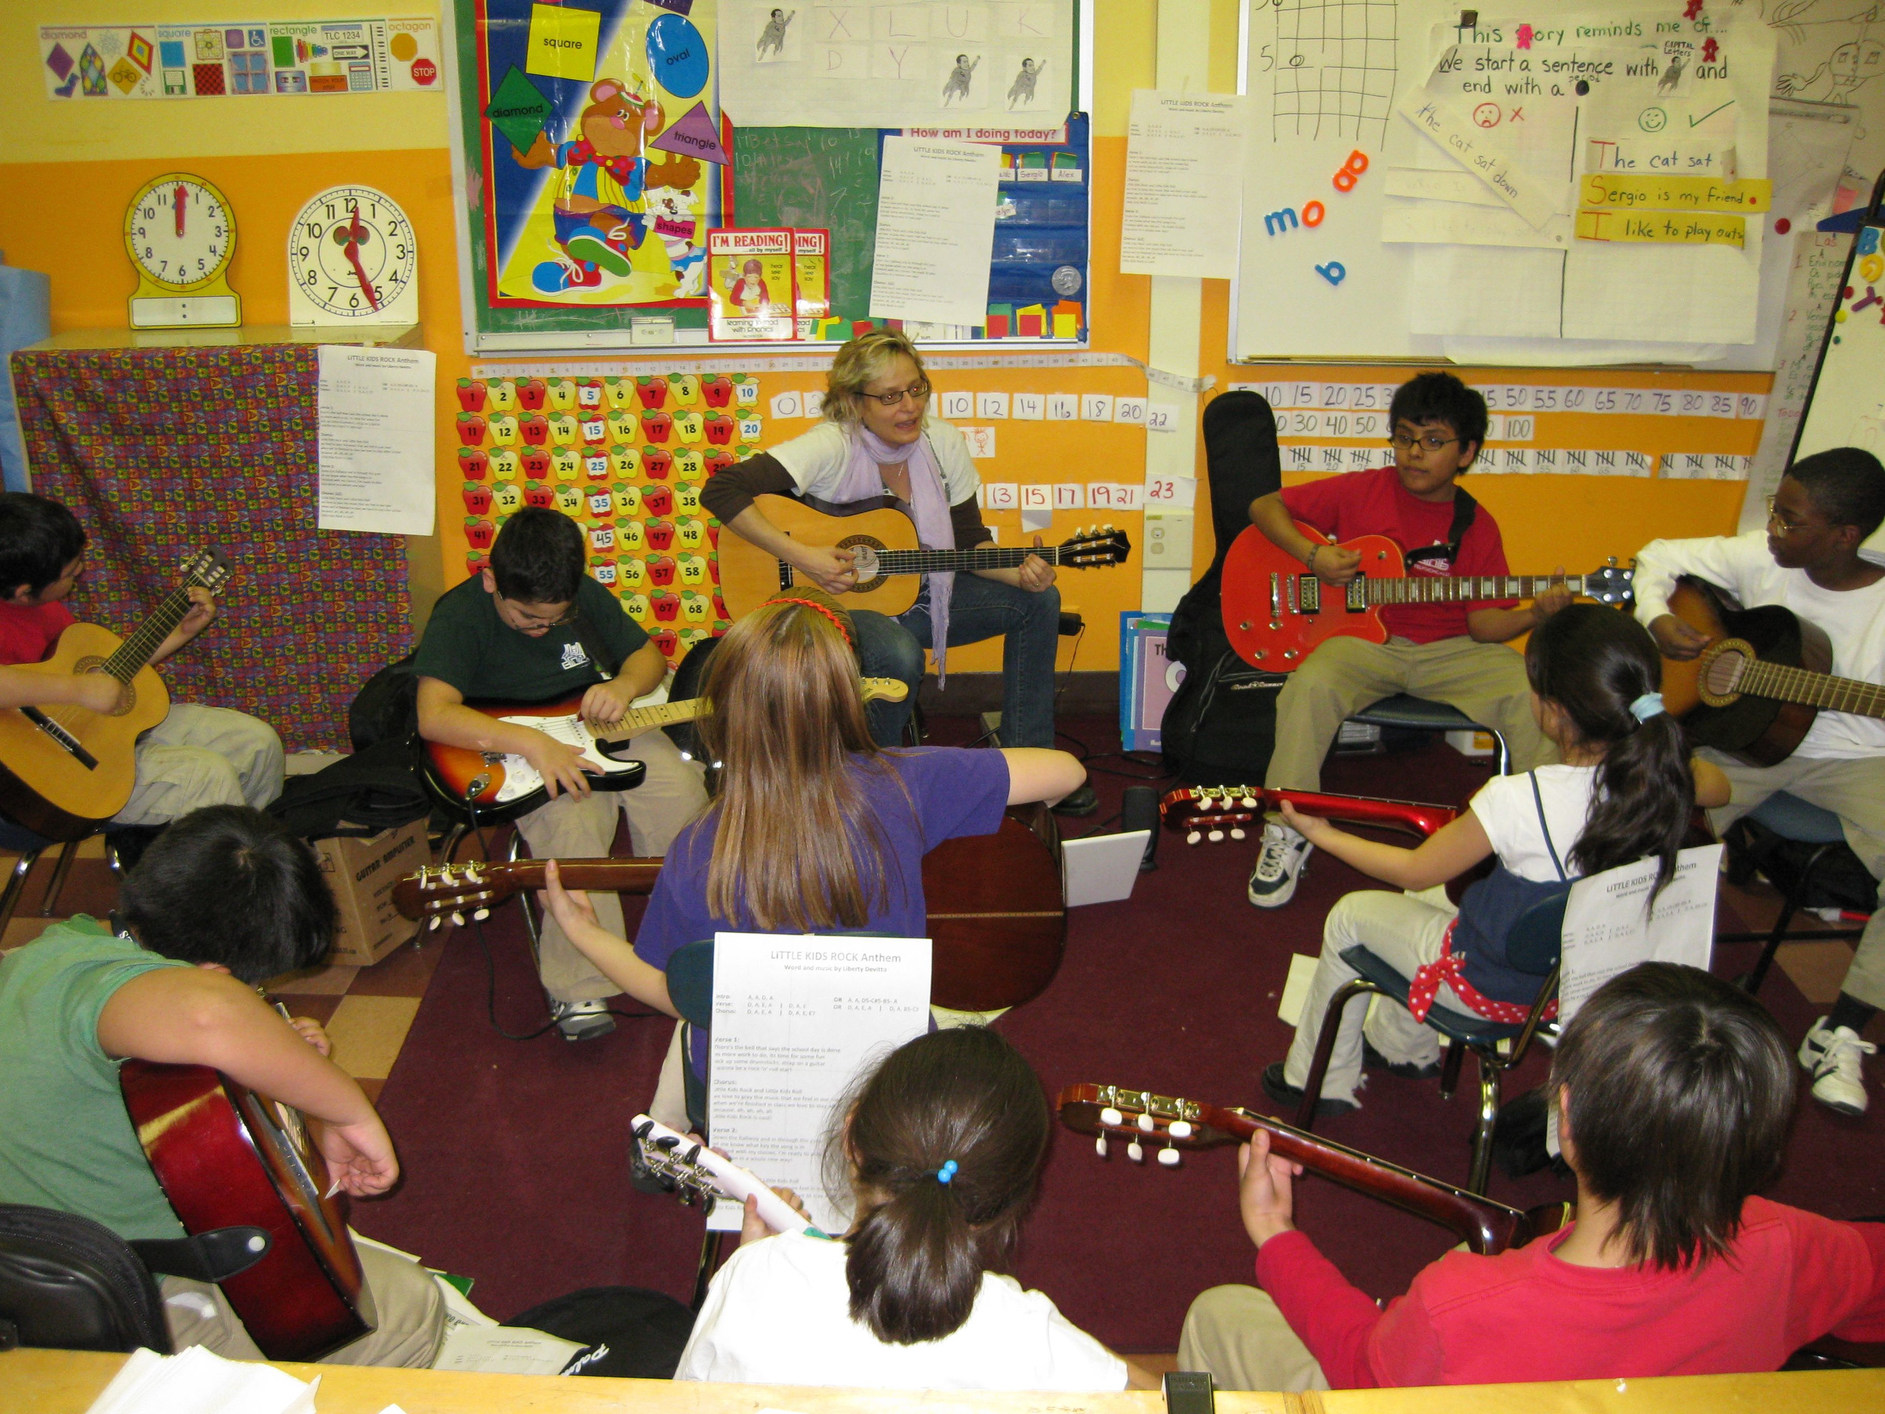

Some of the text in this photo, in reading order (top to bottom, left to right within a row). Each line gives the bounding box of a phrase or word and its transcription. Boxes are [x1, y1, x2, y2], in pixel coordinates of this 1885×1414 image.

[157, 29, 191, 39] square
[269, 24, 317, 36] rectangle
[388, 22, 432, 32] octagon
[1453, 23, 1503, 44] This
[1576, 20, 1642, 38] reminds
[1656, 21, 1680, 33] me
[40, 30, 87, 40] diamond
[324, 31, 361, 40] TLC 1234
[543, 37, 583, 51] square
[665, 48, 691, 66] oval
[1439, 47, 1727, 79] We start a sentence with and
[413, 67, 435, 77] STOP
[1462, 75, 1565, 96] end with a
[492, 104, 544, 118] diamond
[673, 130, 717, 151] triangle
[911, 128, 1057, 141] How am I doing today?
[1590, 140, 1713, 169] The cat sat
[1449, 133, 1474, 154] cat
[1473, 153, 1497, 178] sat
[1493, 168, 1520, 200] down
[1587, 175, 1647, 205] Sergio
[1657, 188, 1670, 201] is
[1679, 193, 1699, 204] my
[158, 194, 167, 205] 11
[344, 198, 358, 213] 12
[144, 207, 155, 219] 10
[208, 206, 215, 217] 2
[325, 204, 335, 219] 11
[138, 227, 146, 238] 9
[215, 226, 222, 237] 3
[306, 223, 322, 239] 10
[388, 221, 398, 236] 2
[656, 221, 693, 236] shapes
[1625, 219, 1655, 238] like
[1664, 219, 1678, 236] to
[1685, 222, 1712, 241] play
[712, 233, 788, 252] I'M READING!
[299, 246, 309, 262] 9
[396, 244, 406, 260] 3
[179, 265, 186, 276] 6
[349, 293, 360, 308] 6
[374, 286, 383, 301] 5
[500, 387, 753, 401] 2 3 4 5 6 8 10
[1292, 386, 1376, 407] 15 20 25
[1506, 388, 1757, 415] 50 55 60 65 70 75 80 85 90
[948, 396, 969, 414] 10
[982, 399, 1001, 416] 12
[1020, 397, 1037, 415] 14
[1088, 399, 1105, 417] 18
[1120, 405, 1142, 420] 20
[1148, 412, 1168, 427] 22
[499, 424, 758, 436] 12 15 18 20
[1294, 414, 1376, 435] 30 40 50
[1507, 419, 1531, 438] 100
[498, 462, 697, 472] 22 25 28
[991, 481, 1174, 505] 13 15 17 19 21 23
[594, 497, 697, 508] 35 38
[596, 532, 638, 545] 45 46
[685, 567, 700, 576] 58
[659, 603, 673, 612] 67
[1606, 875, 1648, 893] LITTLE KIDS
[770, 951, 901, 963] LITTLE KIDS ROCK Anthem
